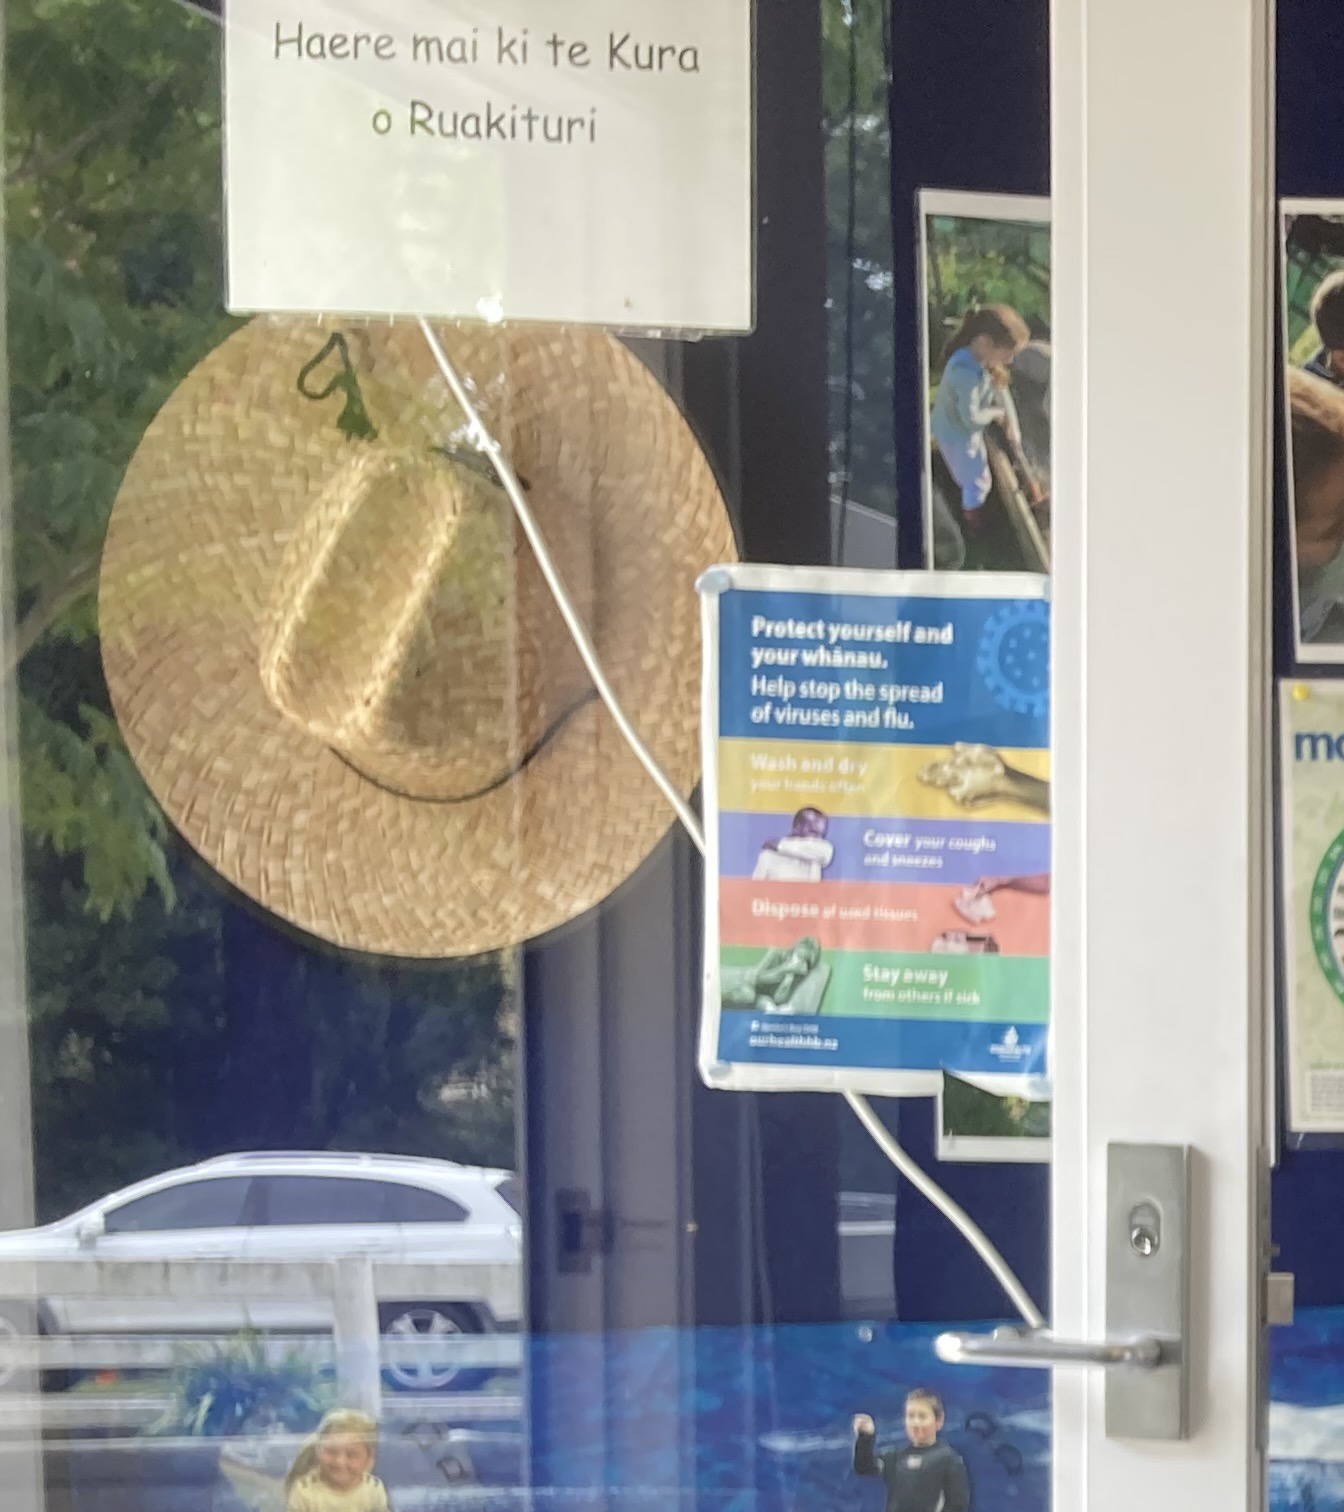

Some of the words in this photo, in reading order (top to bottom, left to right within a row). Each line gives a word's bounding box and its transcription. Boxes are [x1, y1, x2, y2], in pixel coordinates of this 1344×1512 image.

[274, 22, 396, 61] Haere
[412, 29, 478, 64] mai
[497, 27, 529, 66] ki
[545, 33, 591, 68] te
[608, 32, 700, 73] Kura
[372, 109, 392, 135] o
[409, 100, 597, 144] Ruakituri
[752, 615, 825, 640] Protect
[829, 620, 912, 645] yourself
[913, 622, 954, 645] and
[751, 646, 798, 669] your
[801, 644, 888, 670] whānau.
[751, 674, 796, 702] Help
[799, 678, 841, 704] stop
[844, 678, 876, 701] the
[879, 681, 944, 705] spread
[751, 701, 773, 724] of
[774, 703, 840, 728] viruses
[843, 706, 880, 729] and
[883, 706, 914, 730] flu.
[751, 753, 796, 772] Wash
[800, 757, 834, 774] and
[838, 757, 868, 777] dry
[863, 829, 911, 850] Cover
[914, 836, 946, 852] your
[948, 836, 997, 855] coughs
[863, 851, 889, 867] and
[751, 898, 820, 922] Dispose
[822, 904, 837, 920] of
[862, 963, 900, 987] Stay
[902, 966, 949, 988] away
[863, 987, 895, 1003] from
[898, 988, 942, 1005] others
[943, 990, 953, 1005] if
[955, 991, 981, 1006] sick
